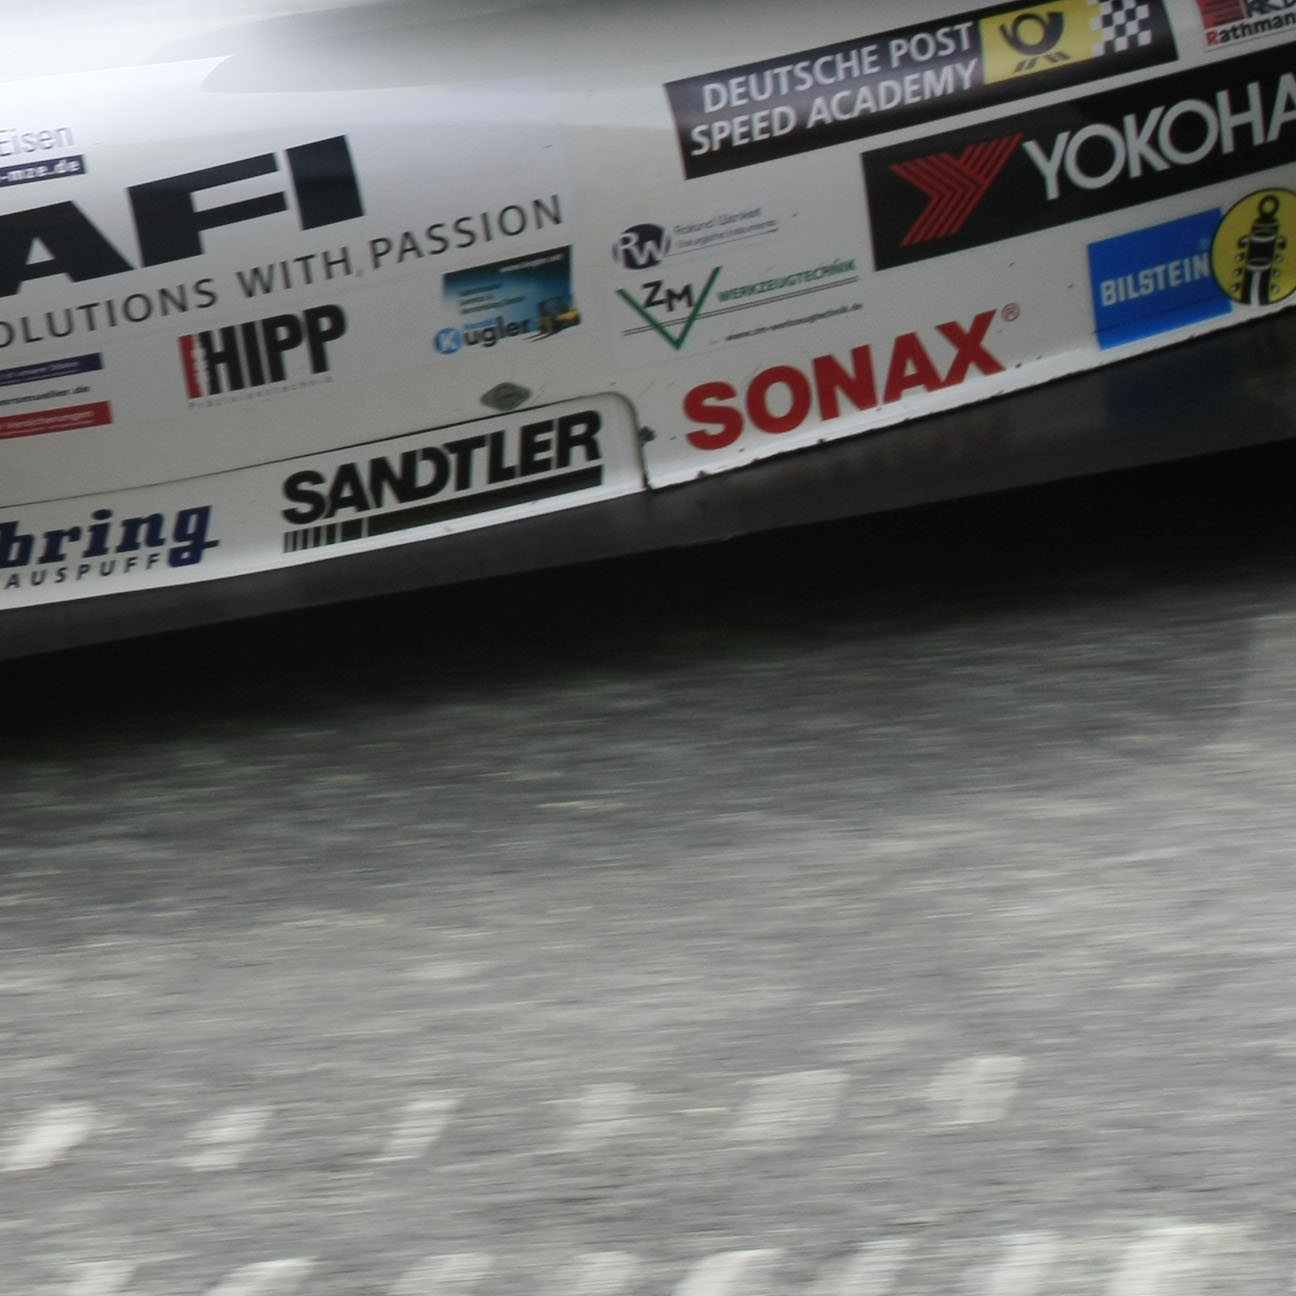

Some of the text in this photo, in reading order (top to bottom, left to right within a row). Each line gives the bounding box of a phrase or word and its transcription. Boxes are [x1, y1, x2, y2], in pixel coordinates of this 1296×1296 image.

[690, 58, 978, 157] SPEED ACADEMY
[702, 20, 975, 115] DEUTSCHE POST
[235, 246, 353, 299] WITH
[368, 194, 564, 271] PASSION
[1100, 252, 1212, 308] BILSTEIN
[641, 280, 694, 313] ZM
[198, 304, 348, 396] HIPP
[682, 308, 1007, 451] SONAX
[282, 409, 602, 526] SANDTLER
